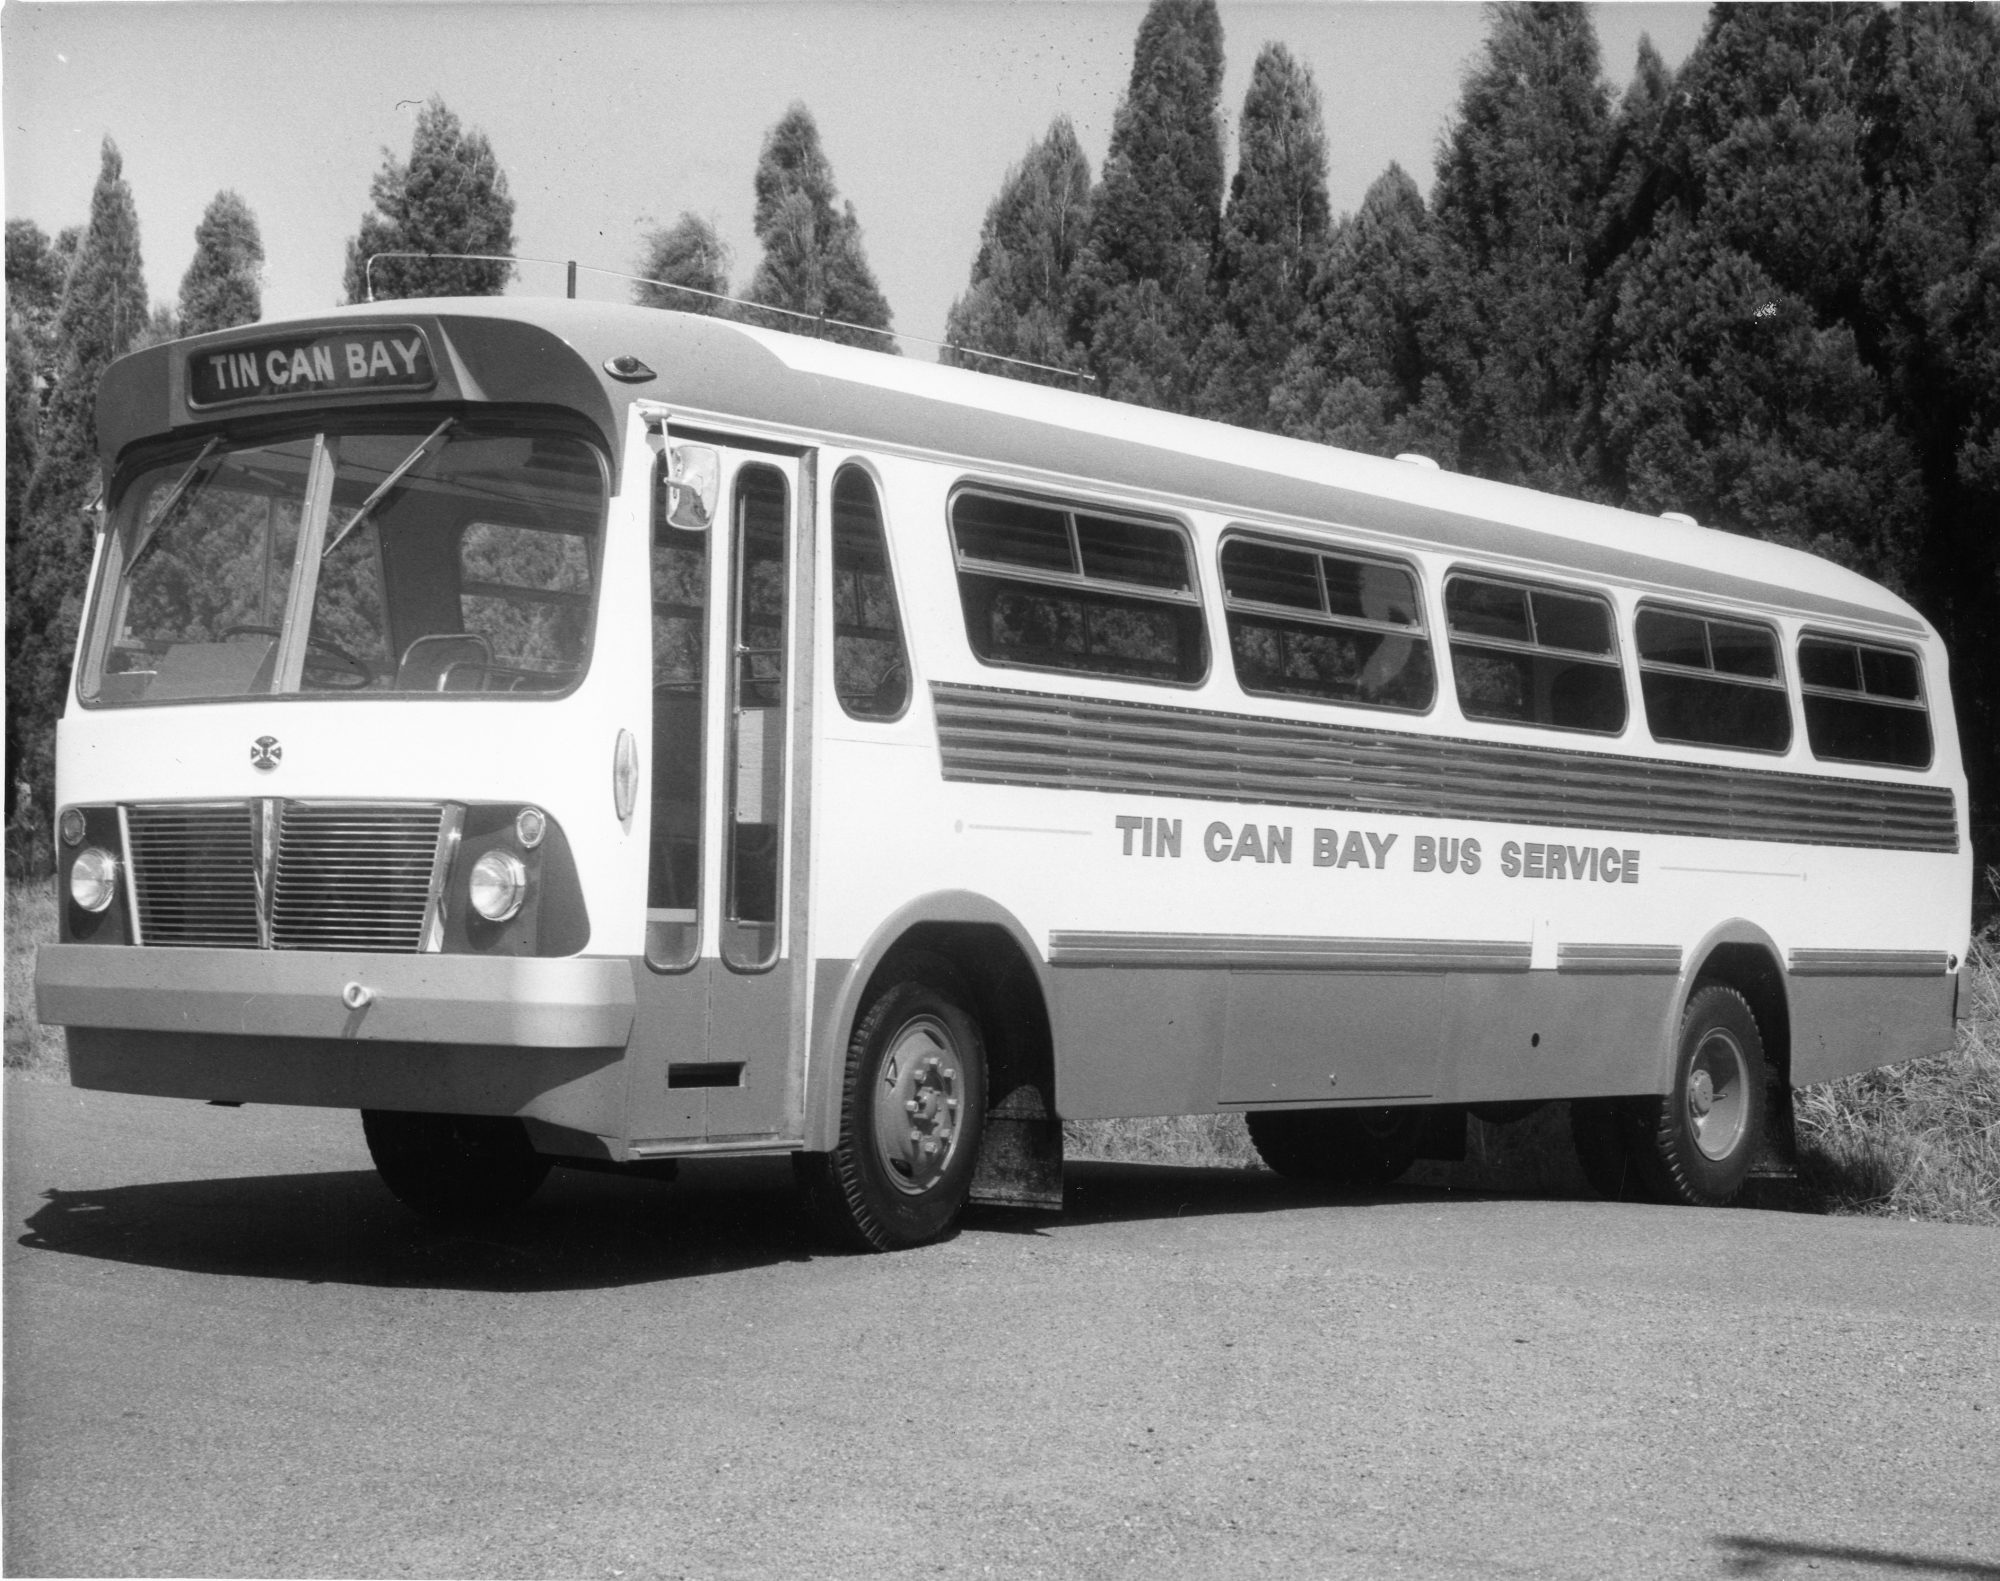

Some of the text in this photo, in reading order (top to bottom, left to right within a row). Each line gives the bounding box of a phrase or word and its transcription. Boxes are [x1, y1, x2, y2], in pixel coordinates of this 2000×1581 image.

[209, 338, 421, 389] TIN CAN BAY
[1115, 815, 1640, 883] TIN CAN BAY BUS SERVICE
